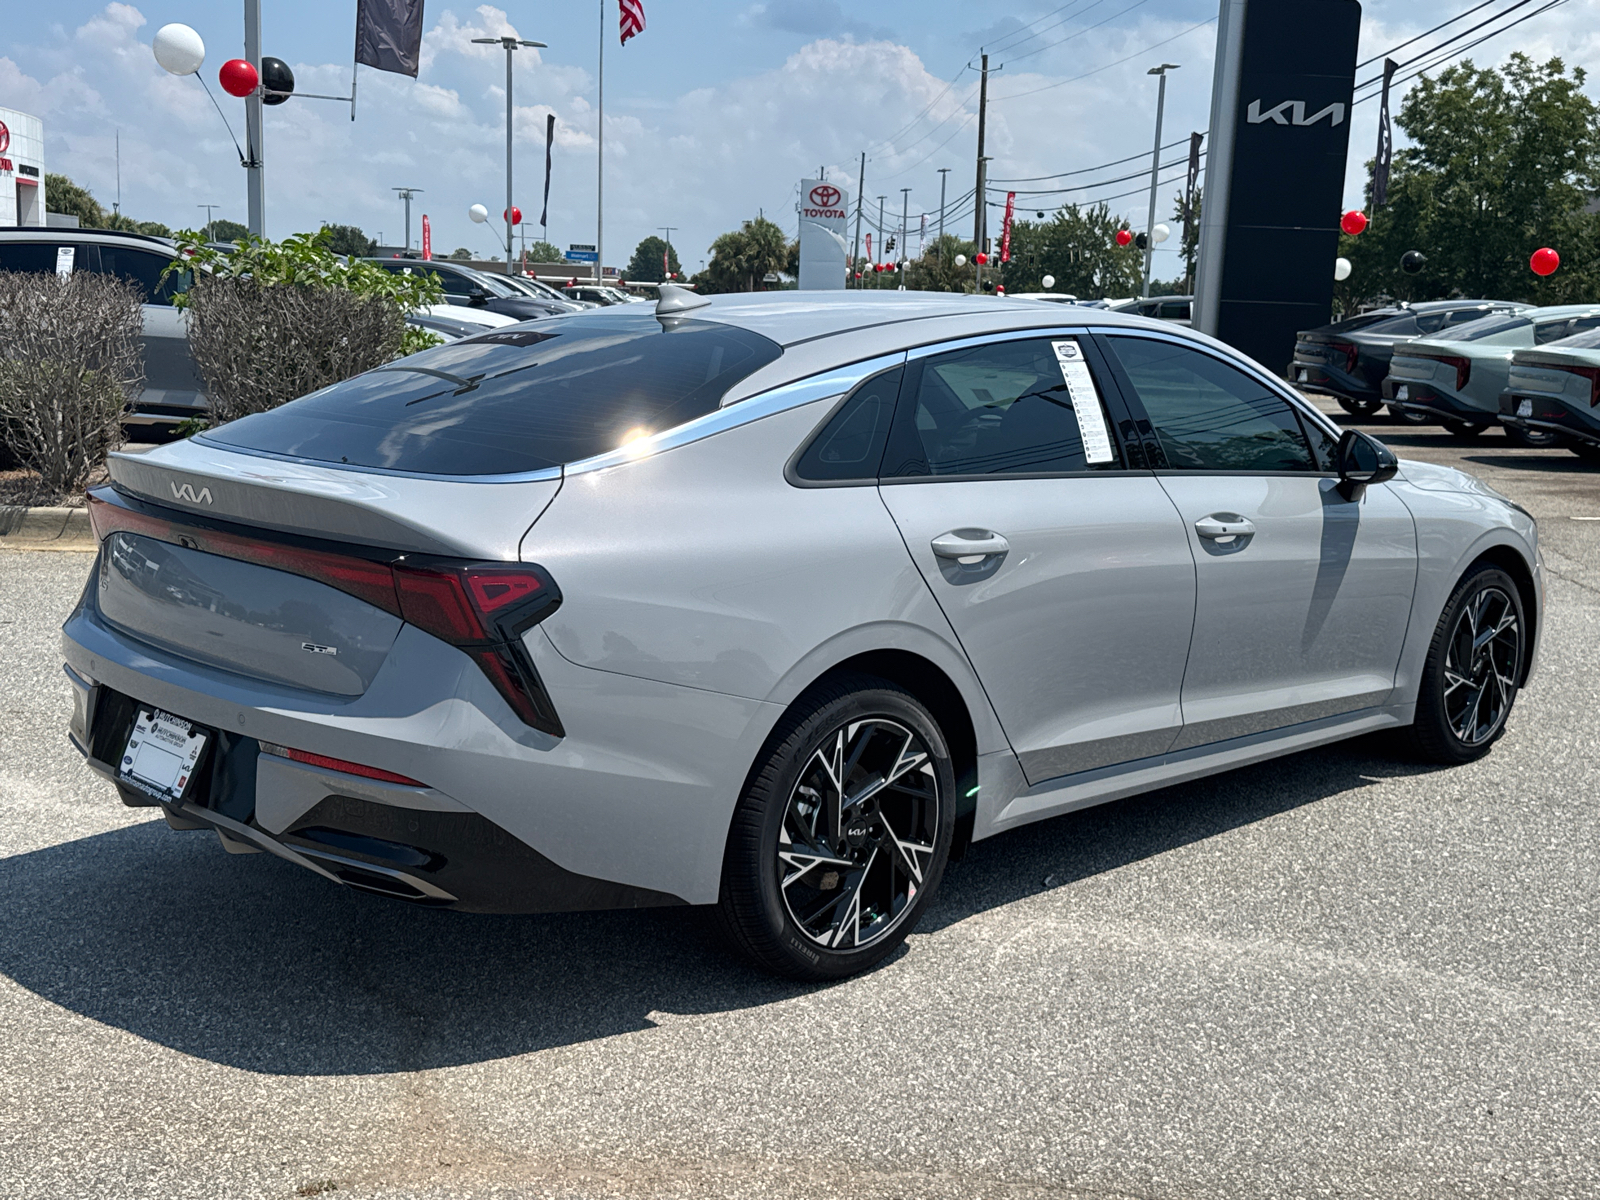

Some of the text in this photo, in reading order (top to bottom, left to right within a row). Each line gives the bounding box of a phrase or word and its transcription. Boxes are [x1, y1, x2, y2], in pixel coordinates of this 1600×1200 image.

[1247, 98, 1345, 127] KIA
[803, 208, 846, 219] TOYOTA
[171, 480, 213, 505] KIA
[157, 726, 188, 745] HUTCHINSON
[848, 828, 867, 836] KIA
[790, 937, 821, 966] PIRELLI
